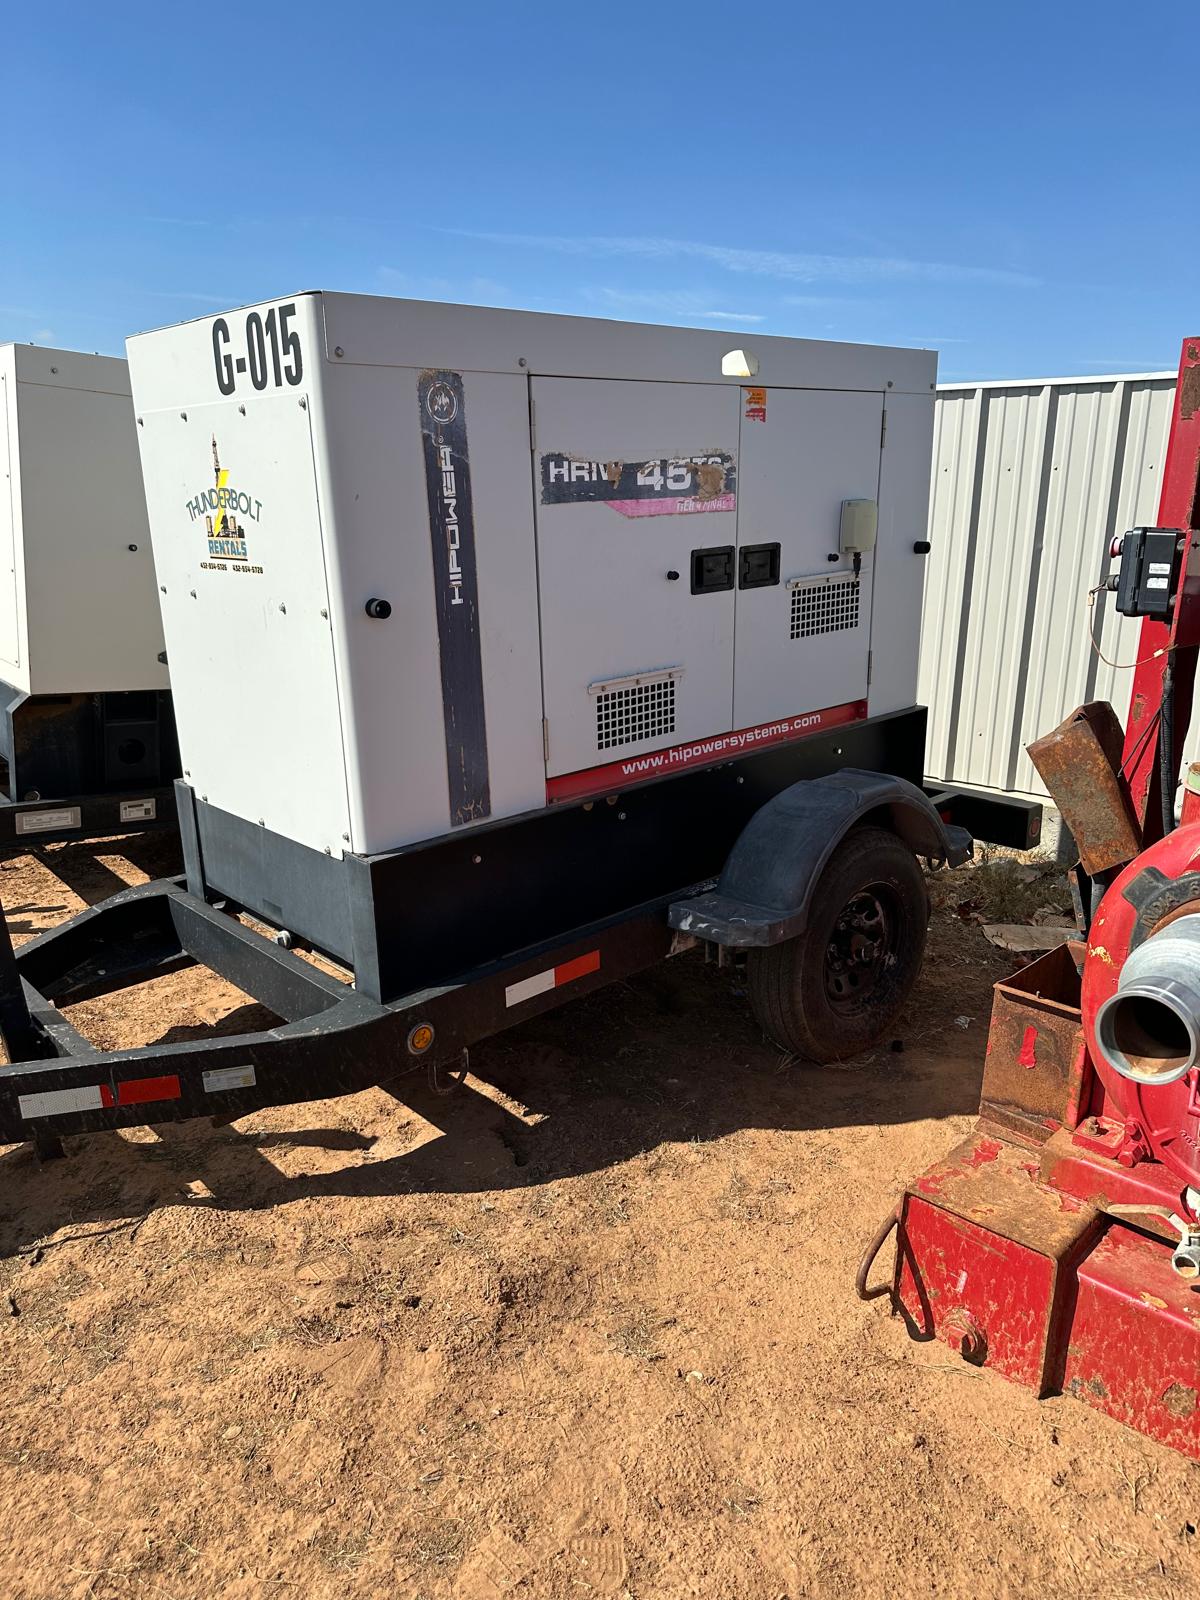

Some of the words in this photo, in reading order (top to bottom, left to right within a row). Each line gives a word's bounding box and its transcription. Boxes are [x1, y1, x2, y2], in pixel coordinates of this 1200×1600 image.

[212, 303, 303, 396] G-015
[185, 487, 263, 523] THUNDERBOLT
[440, 445, 465, 606] HIPOWER
[208, 539, 248, 557] RENTALS
[621, 713, 822, 776] www.hipowersystems.com
